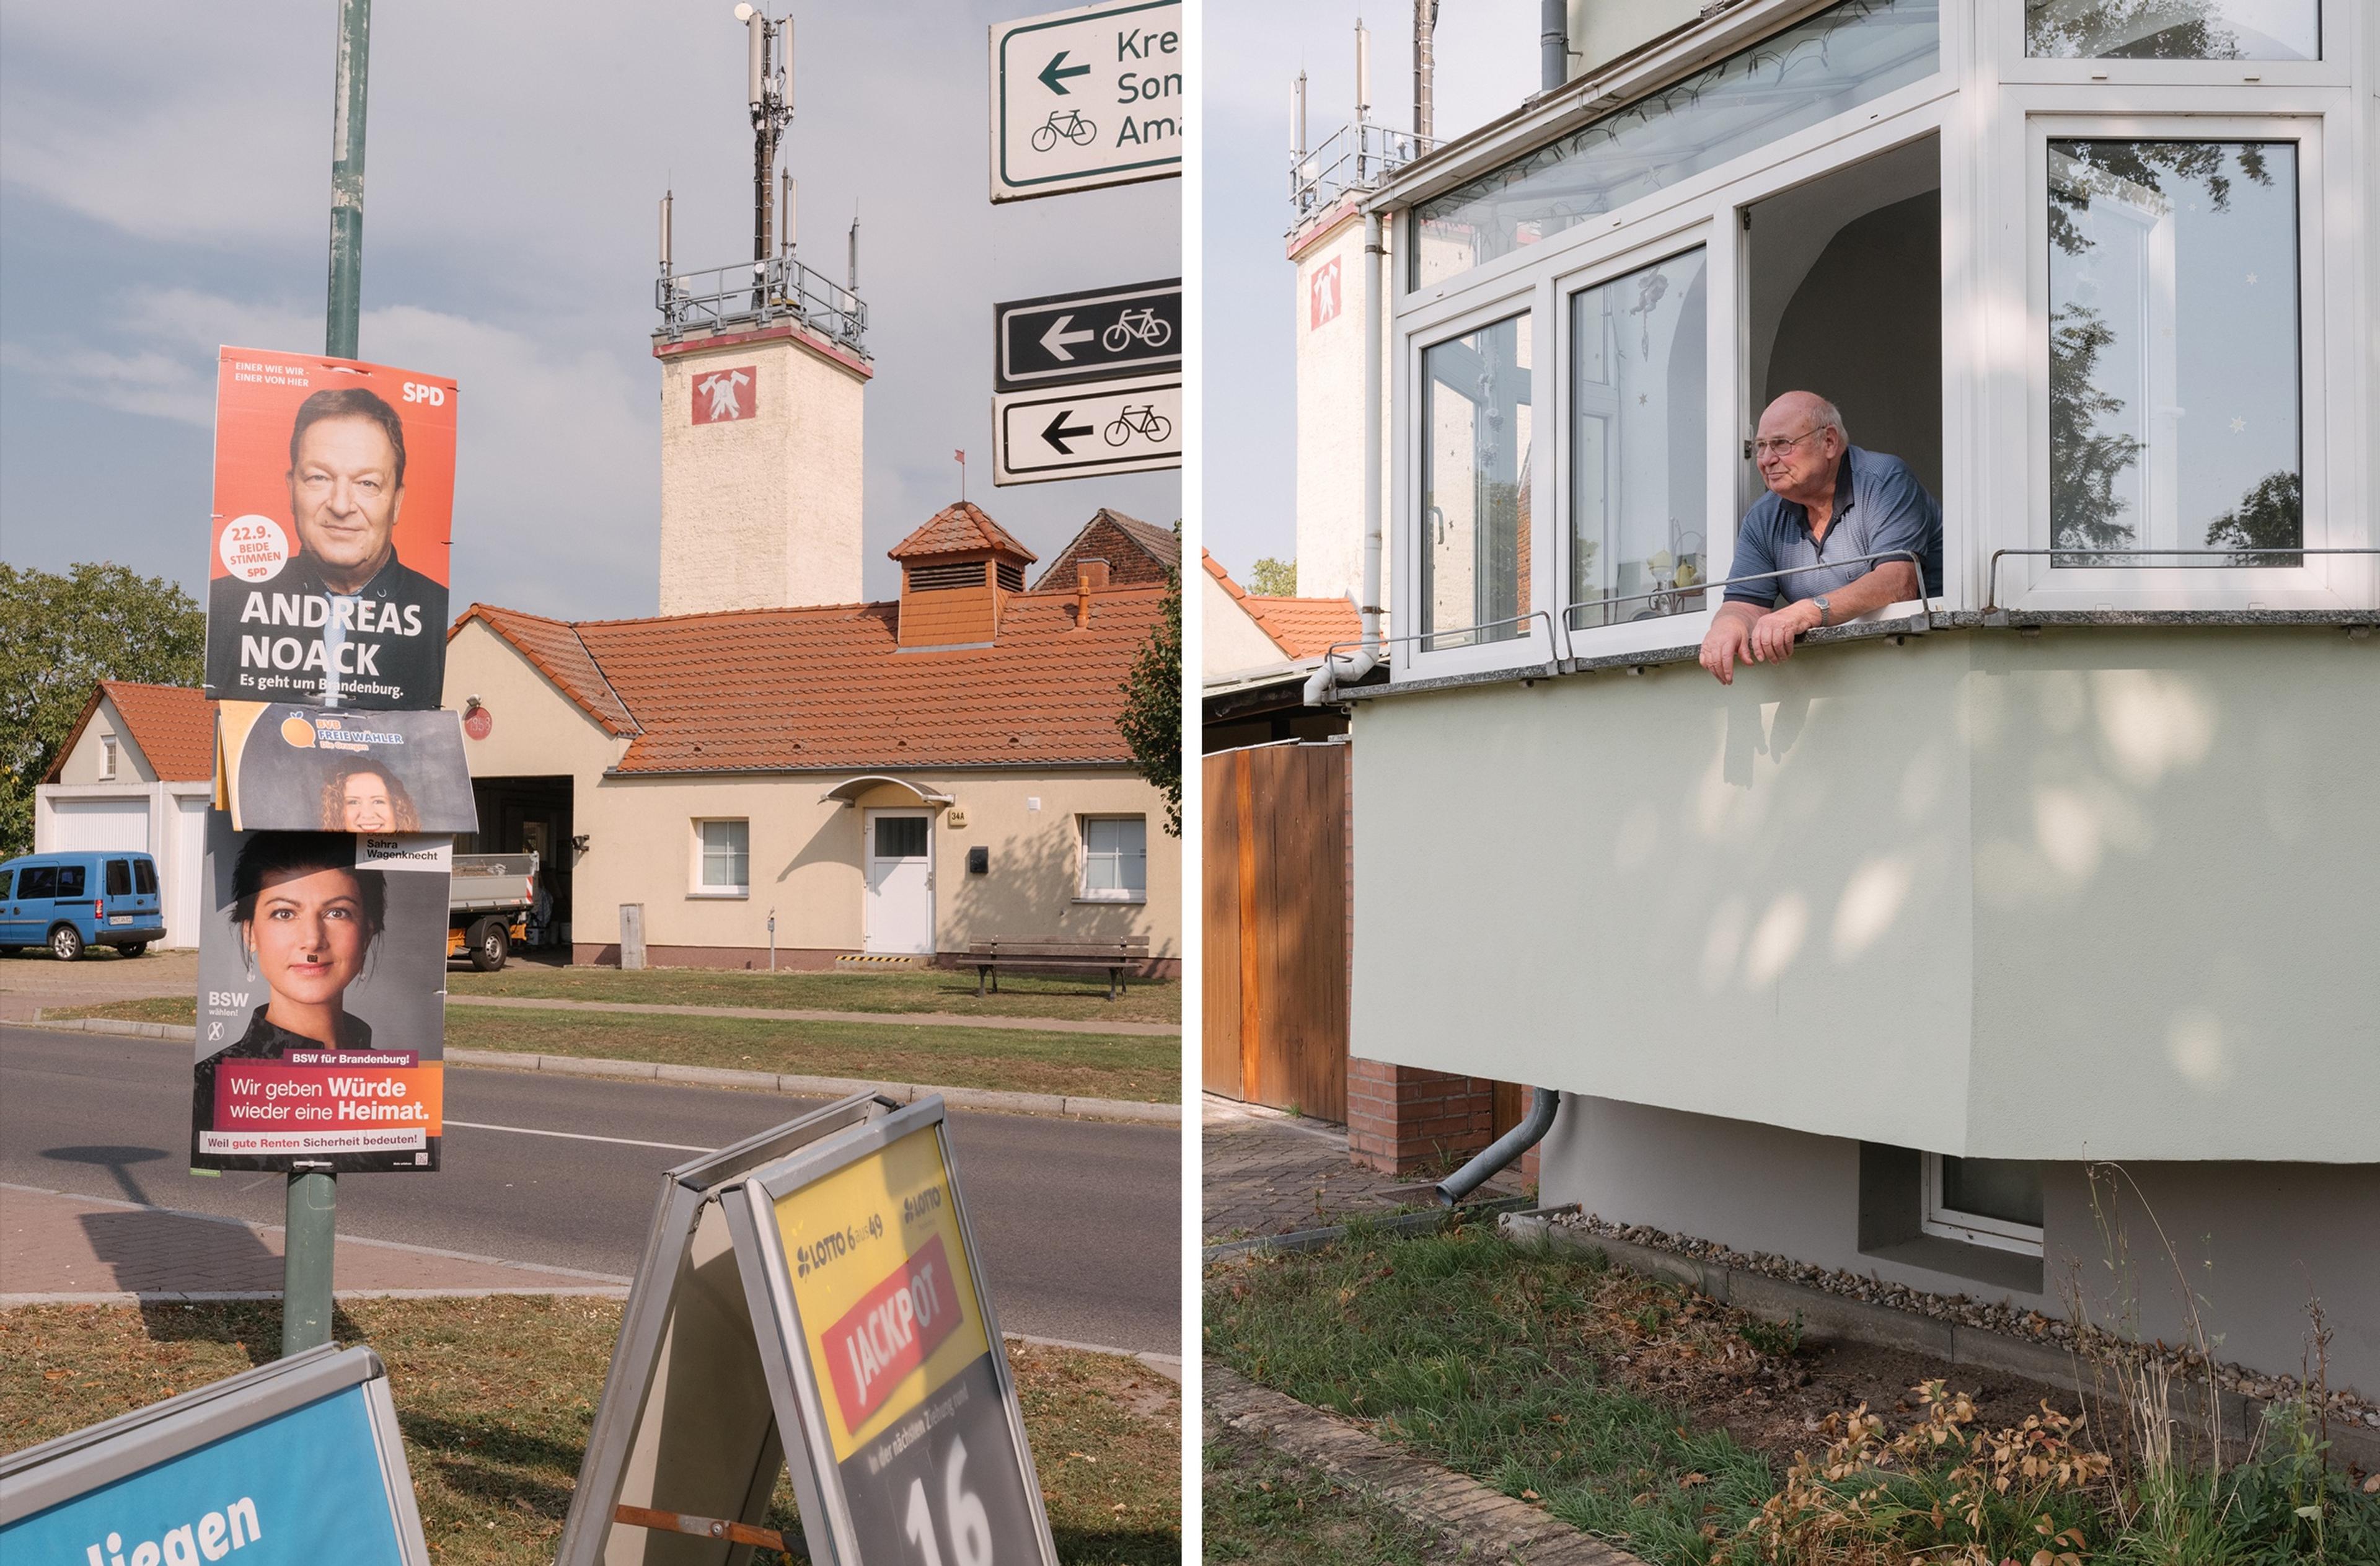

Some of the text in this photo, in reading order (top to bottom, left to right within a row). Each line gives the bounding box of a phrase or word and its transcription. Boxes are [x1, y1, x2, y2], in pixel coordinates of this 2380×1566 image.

[1118, 28, 1178, 62] Kre
[1116, 115, 1181, 148] Am
[236, 362, 263, 371] EINER
[265, 365, 283, 373] WIE
[285, 366, 304, 376] WIR
[235, 373, 309, 387] EINER VON HIER
[402, 381, 444, 407] SPD
[232, 525, 271, 541] 22.9.
[239, 542, 270, 554] BEIDE
[230, 551, 281, 565] STIMMEN
[247, 567, 268, 577] SPD
[240, 591, 422, 637] ANDREAS
[240, 635, 381, 676] NOACK
[240, 673, 254, 686] Es
[258, 676, 289, 690] geht
[293, 679, 315, 689] um
[315, 719, 341, 729] BVB
[318, 730, 403, 744] FREIE WÄHLER
[951, 812, 964, 820] 34A
[367, 839, 398, 849] Sahra
[367, 849, 438, 860] Wagenknecht
[209, 991, 249, 1007] BSW
[208, 1008, 238, 1016] wählen!
[293, 1053, 410, 1065] BSW für Brandenburg!
[231, 1077, 407, 1100] Wir geben Würde
[230, 1100, 430, 1121] wieder eine Heimat.
[208, 1135, 417, 1149] Weil gute Renten Sicherheit bedeuten!
[913, 1186, 941, 1217] LOTTO
[809, 1231, 845, 1269] LOTTO
[847, 1262, 940, 1407] JACKPOT
[906, 1433, 993, 1566] 16
